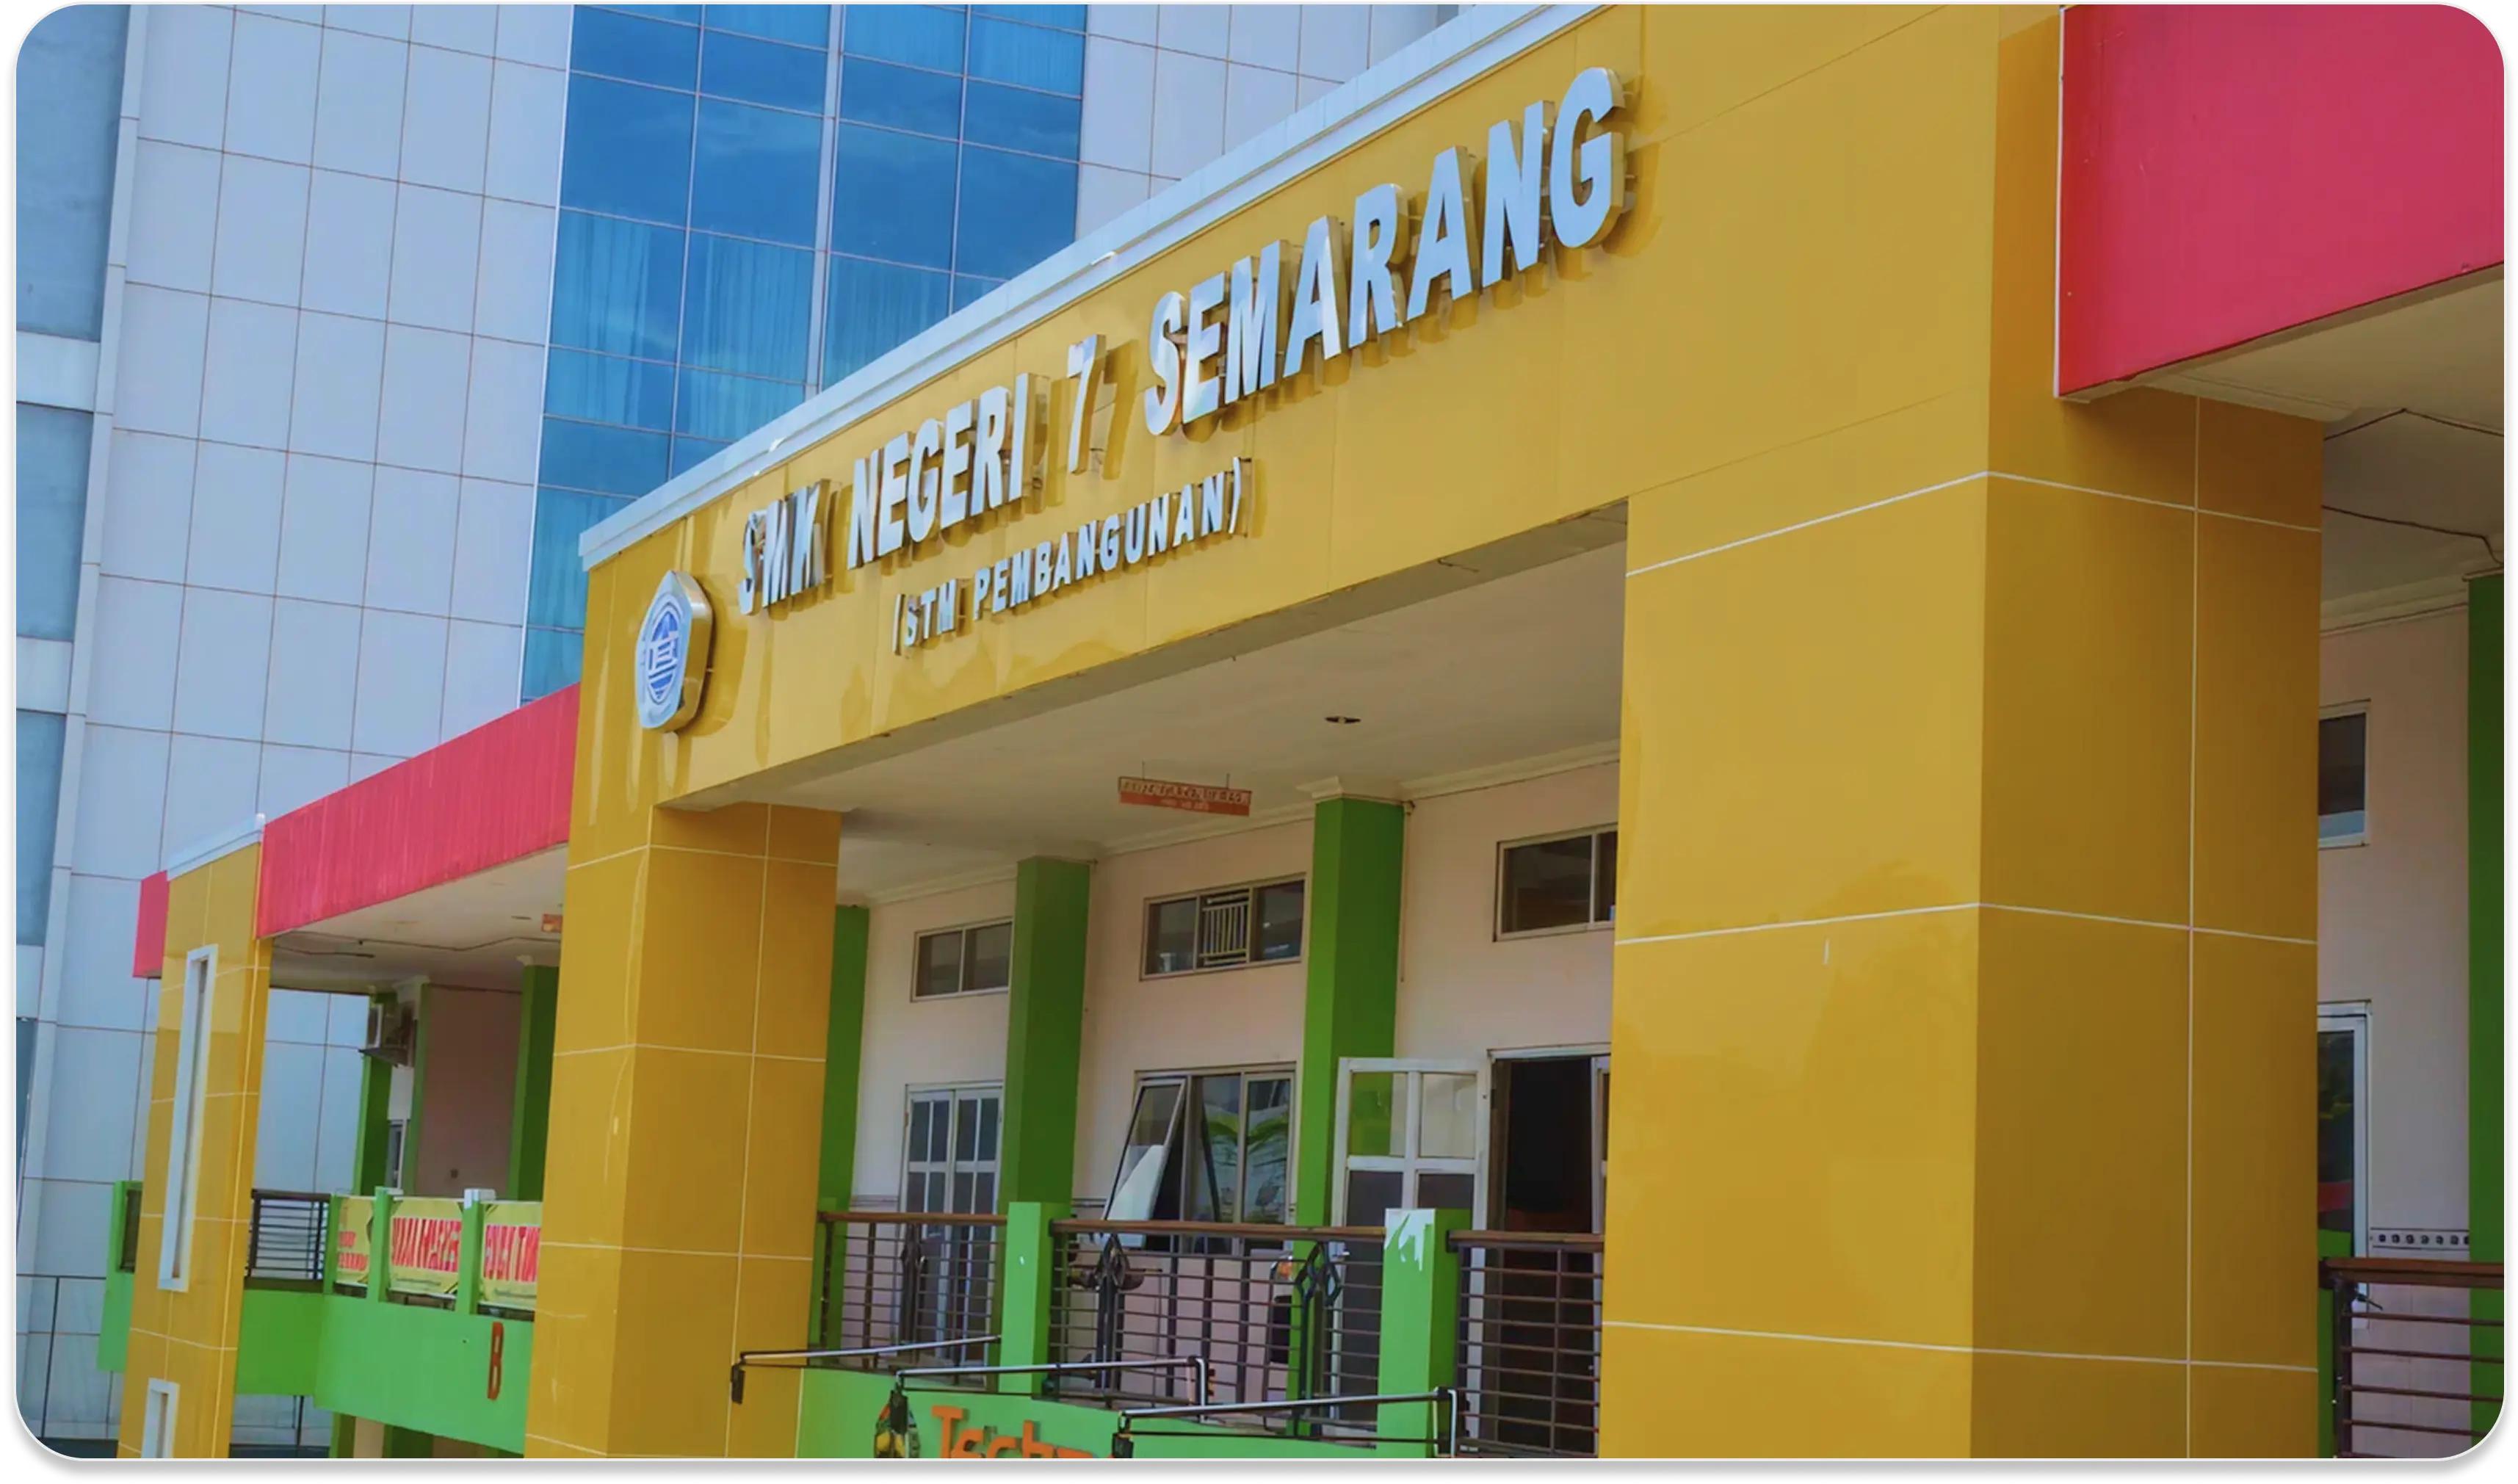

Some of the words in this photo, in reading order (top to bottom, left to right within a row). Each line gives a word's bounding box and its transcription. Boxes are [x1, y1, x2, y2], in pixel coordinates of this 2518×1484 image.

[738, 483, 825, 615] SMK
[847, 371, 1029, 571] NEGERI
[1067, 334, 1101, 474] 7
[1145, 68, 1625, 436] SEMARANG
[972, 457, 1242, 621] PEMBANGUNAN)
